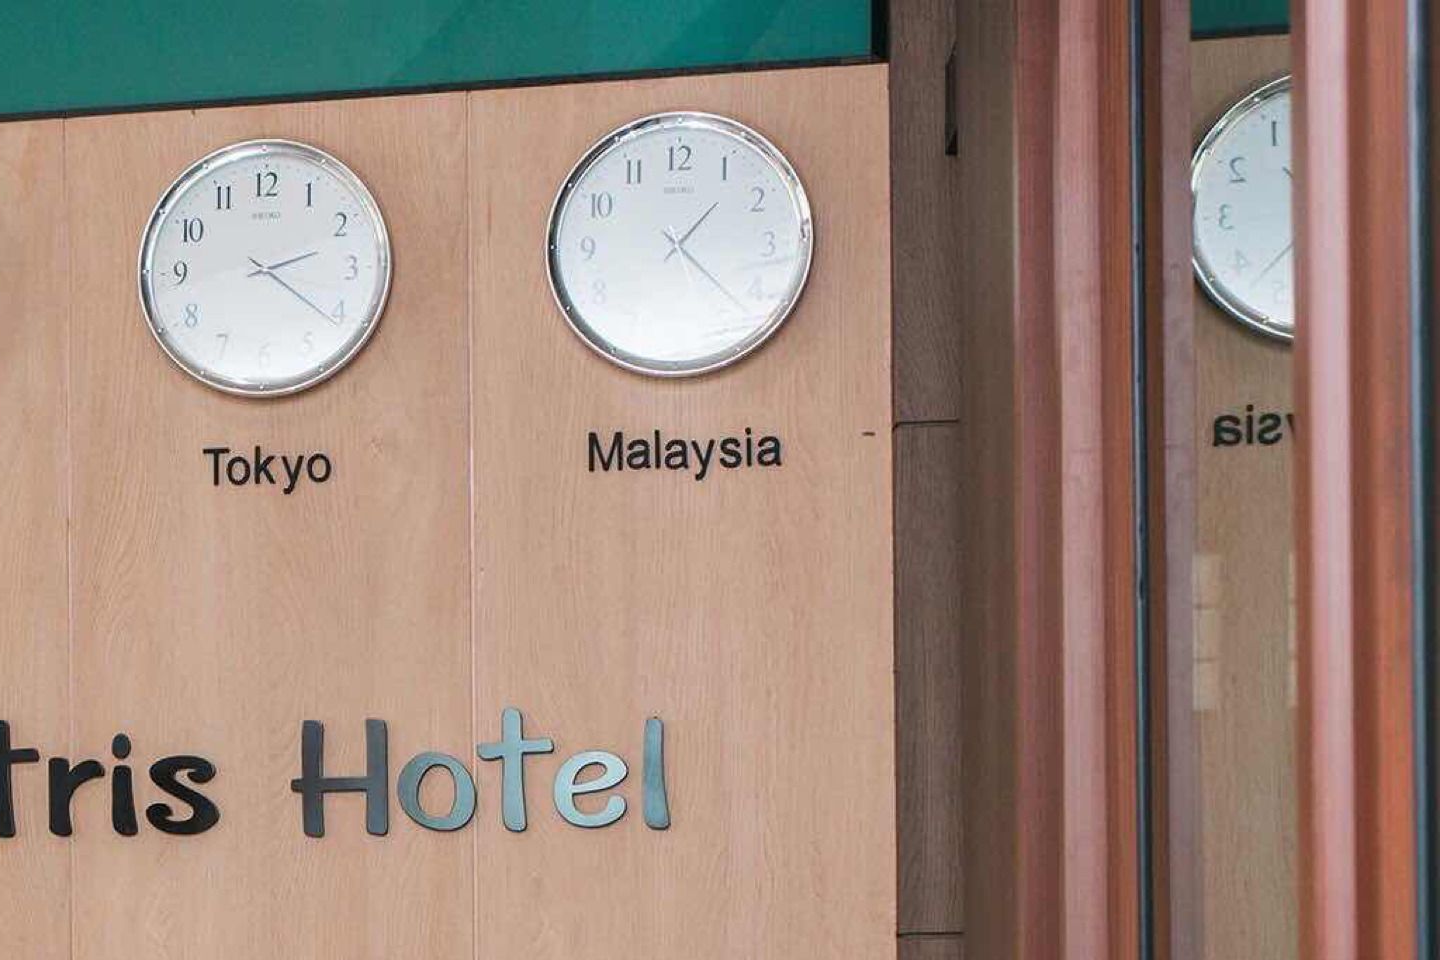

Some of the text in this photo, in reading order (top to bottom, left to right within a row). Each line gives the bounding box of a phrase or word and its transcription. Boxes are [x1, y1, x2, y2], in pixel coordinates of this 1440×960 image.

[668, 145, 692, 171] 12
[722, 156, 727, 180] 1
[627, 159, 641, 184] 11
[256, 172, 278, 197] 12
[306, 183, 312, 207] 1
[216, 185, 231, 210] 11
[591, 192, 612, 217] 10
[751, 187, 765, 212] 2
[183, 218, 203, 243] 10
[334, 212, 347, 237] 2
[580, 236, 596, 261] 9
[760, 231, 776, 257] 3
[173, 262, 188, 285] 9
[345, 255, 358, 280] 3
[185, 304, 198, 328] 8
[216, 333, 228, 358] 7
[588, 426, 783, 482] Malaysia
[202, 445, 332, 496] Tokyo
[290, 706, 673, 840] Hotel
